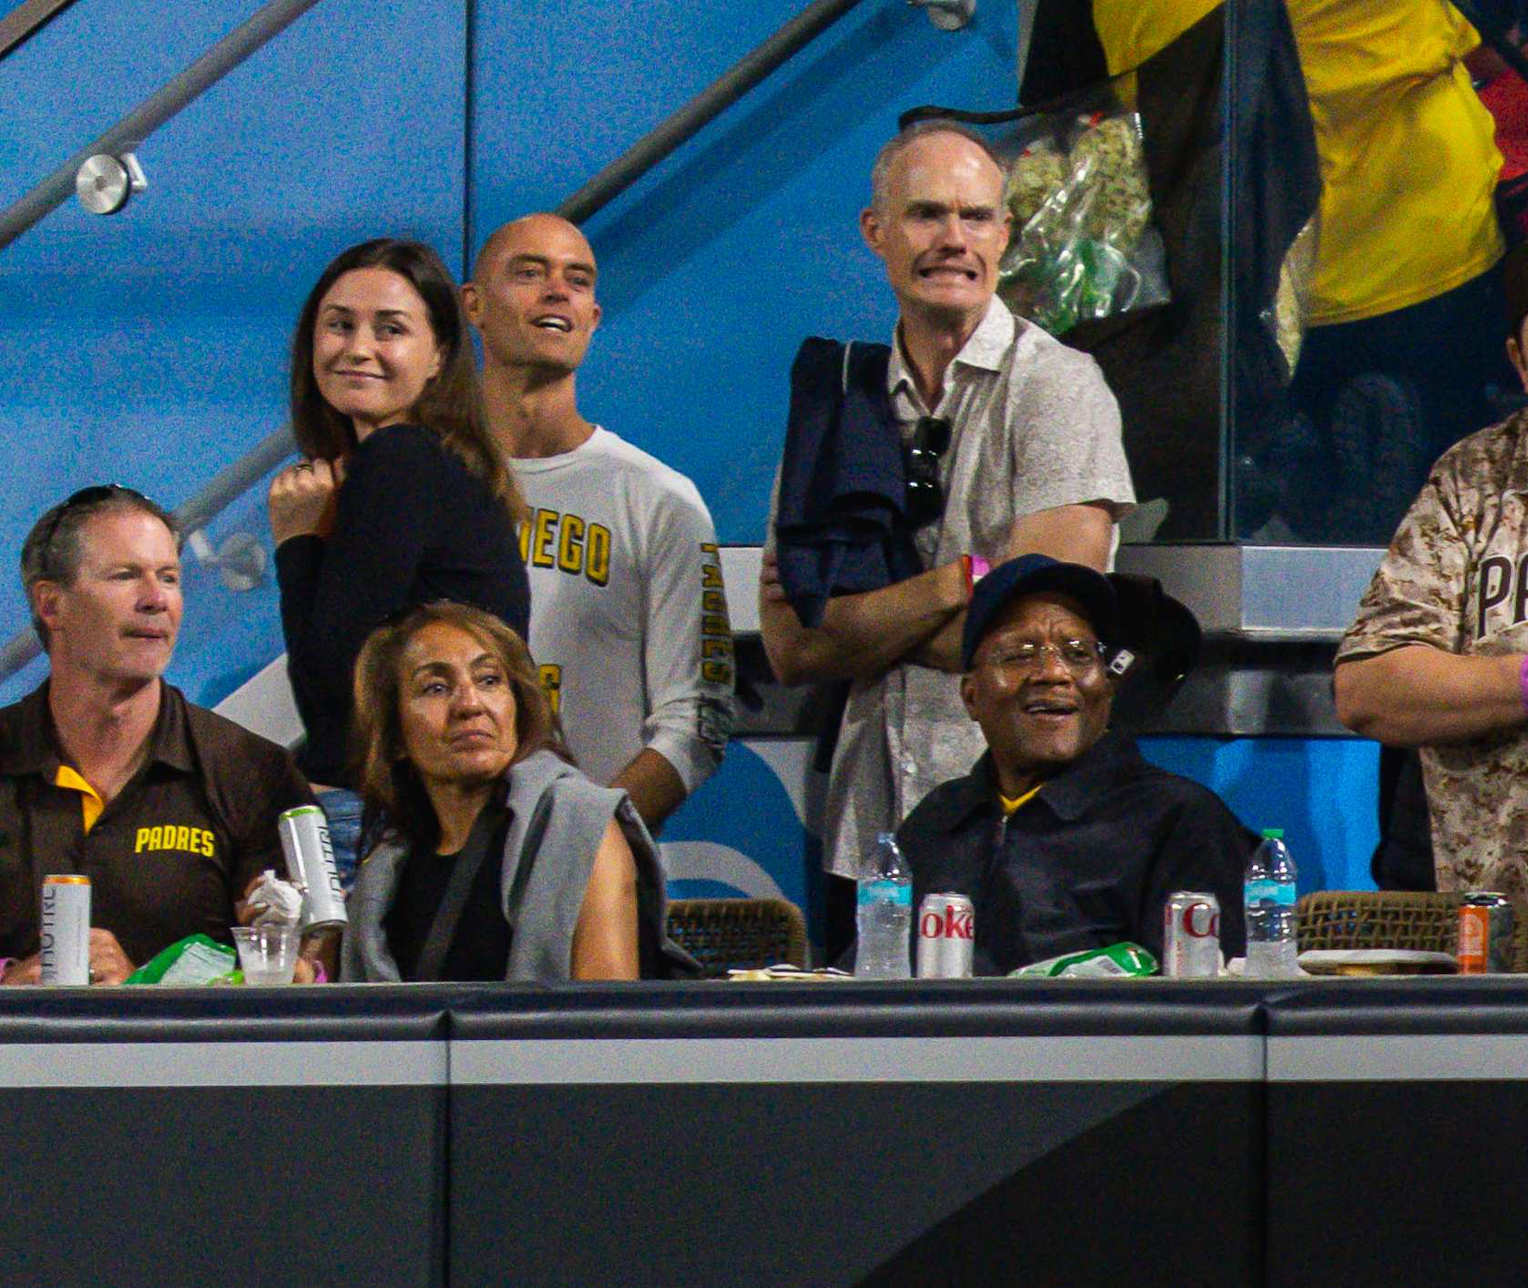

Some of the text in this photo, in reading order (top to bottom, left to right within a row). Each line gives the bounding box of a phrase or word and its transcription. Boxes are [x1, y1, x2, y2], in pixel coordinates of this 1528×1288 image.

[518, 505, 612, 588] IEGO
[134, 824, 216, 857] PADRES
[920, 904, 974, 941] oke
